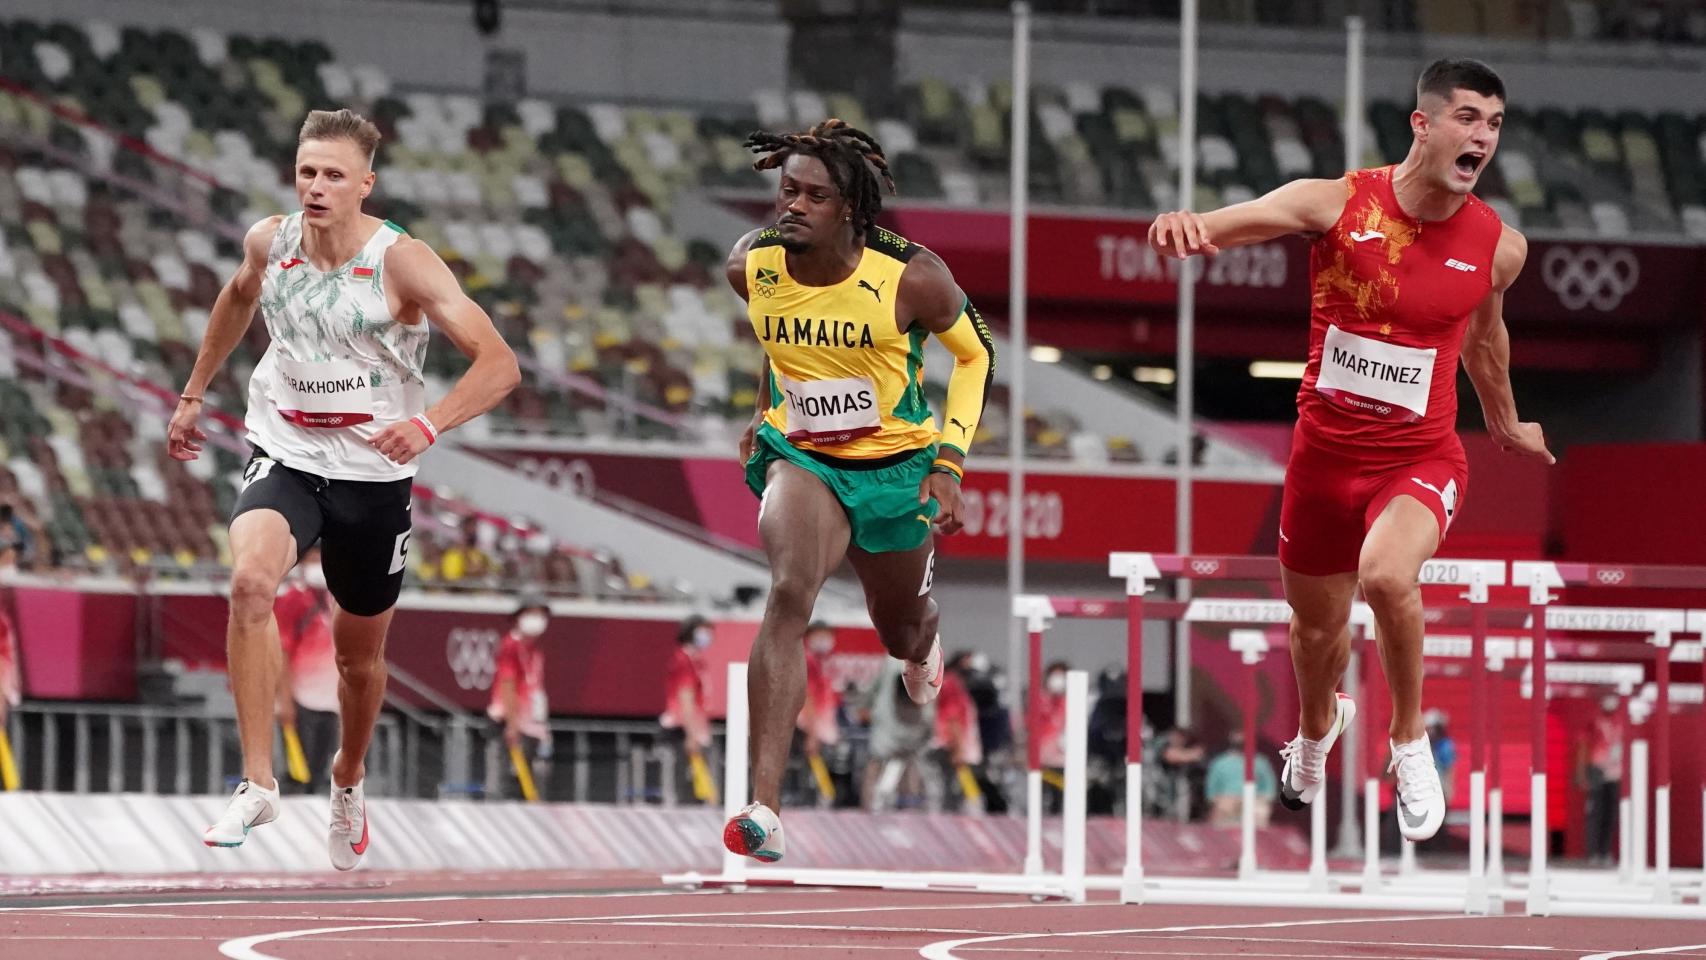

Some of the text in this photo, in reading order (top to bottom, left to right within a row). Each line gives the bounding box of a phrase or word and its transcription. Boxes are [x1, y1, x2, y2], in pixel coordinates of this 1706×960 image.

[1098, 235, 1205, 282] TOK
[1444, 258, 1477, 272] ESP
[762, 315, 875, 348] JAMAICA
[1332, 347, 1422, 384] MARTINEZ
[786, 390, 872, 417] THOMAS
[1344, 397, 1360, 407] TOKYO
[985, 489, 1063, 537] 220
[1423, 564, 1459, 582] 020
[1606, 614, 1646, 629] 2020
